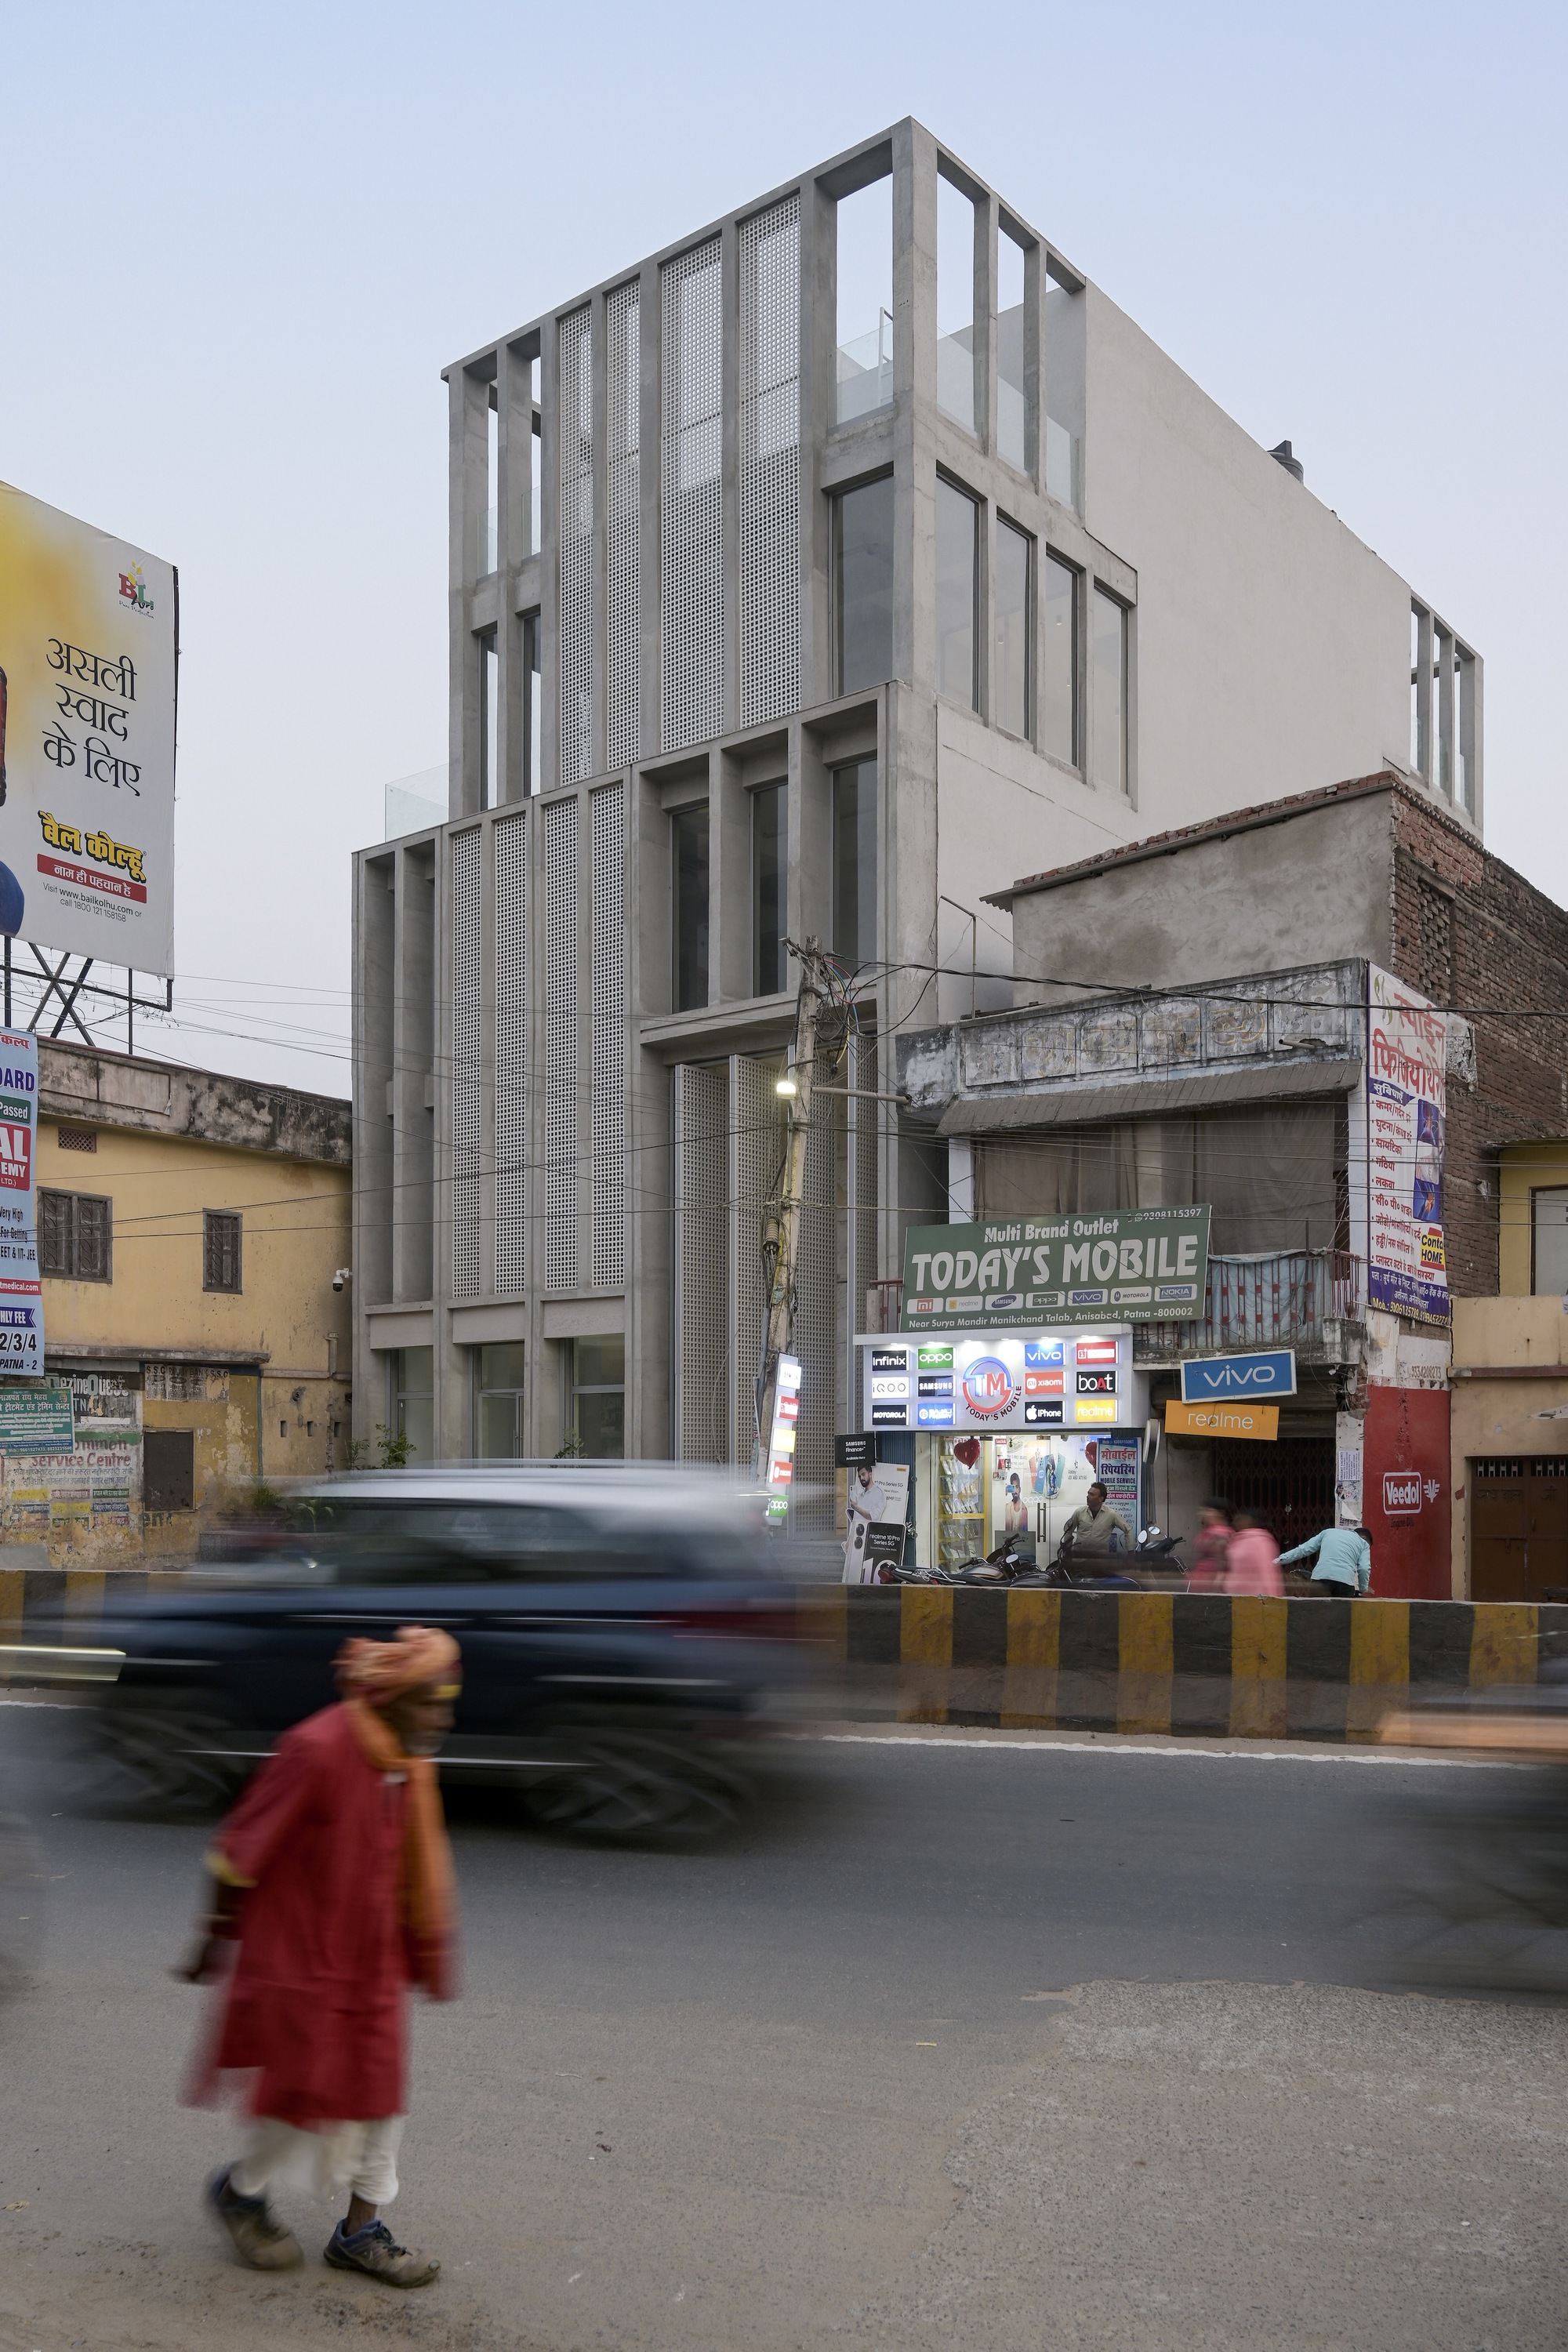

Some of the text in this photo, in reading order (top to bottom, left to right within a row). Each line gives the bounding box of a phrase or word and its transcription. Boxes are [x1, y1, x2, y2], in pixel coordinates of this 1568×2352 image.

[45, 638, 137, 702] असली
[56, 683, 129, 742] स्वाद
[42, 720, 142, 797] के लिए
[38, 810, 147, 884] बैल कोल्हू
[53, 864, 132, 897] नाम ही पहचान है
[43, 882, 142, 918] Visit www.bailkolhu.com or
[60, 898, 126, 923] call 1800 121 158158
[0, 1032, 30, 1050] कल्प
[0, 1067, 34, 1092] ARD
[0, 1162, 26, 1178] EMY
[1376, 1176, 1395, 1189] लकवा
[1143, 1208, 1202, 1221] 9308115397
[0, 1226, 28, 1243] For Getting
[984, 1218, 1119, 1243] Multi Brand Outlet
[12, 1247, 16, 1259] &
[1421, 1249, 1443, 1265] HOME
[911, 1235, 1199, 1292] TODAY'S MOBILE
[14, 1311, 27, 1324] FEE
[909, 1307, 1193, 1329] Near Surya Mandir Manikchand Talab, Anisabad, Patna -800002
[873, 1356, 906, 1366] Infinix
[919, 1352, 953, 1364] oppo
[1027, 1349, 1062, 1361] vivo
[0, 1359, 24, 1370] PATNA
[32, 1360, 38, 1370] 2
[1203, 1364, 1276, 1388] vivo
[26, 1402, 35, 1411] एंड
[965, 1403, 999, 1421] TODAY'S
[1000, 1385, 1022, 1417] MOBILE
[1037, 1409, 1062, 1417] iPhone
[1077, 1406, 1114, 1417] realme
[1188, 1412, 1254, 1429] realme
[87, 1452, 132, 1468] Centre
[1101, 1448, 1137, 1461] मोबाईल
[1101, 1463, 1135, 1475] रिपेयरिंग
[1386, 1481, 1419, 1505] Veedol
[771, 1500, 788, 1511] oppo
